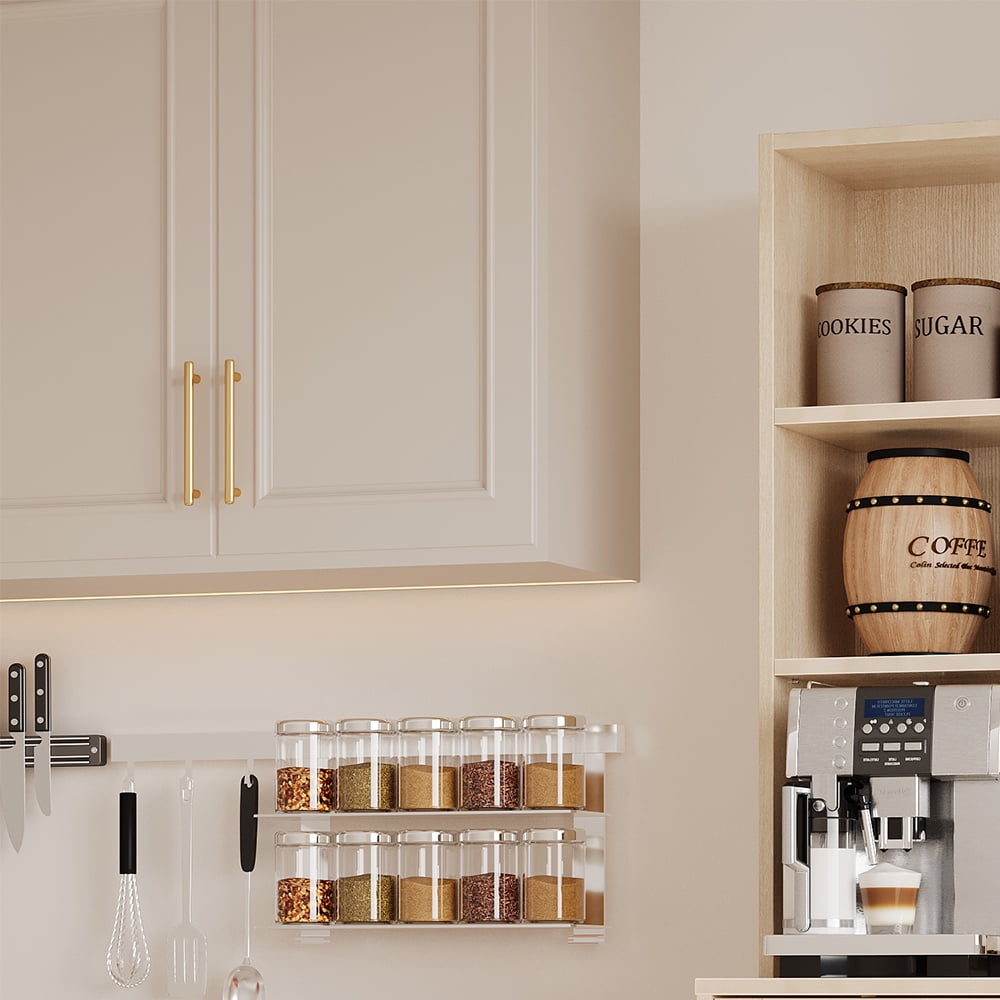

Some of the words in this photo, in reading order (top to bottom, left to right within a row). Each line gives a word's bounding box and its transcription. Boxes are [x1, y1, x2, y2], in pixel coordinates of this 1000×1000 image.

[817, 318, 892, 338] COOKIES
[914, 315, 984, 338] SUGAR
[908, 536, 987, 558] COFFE
